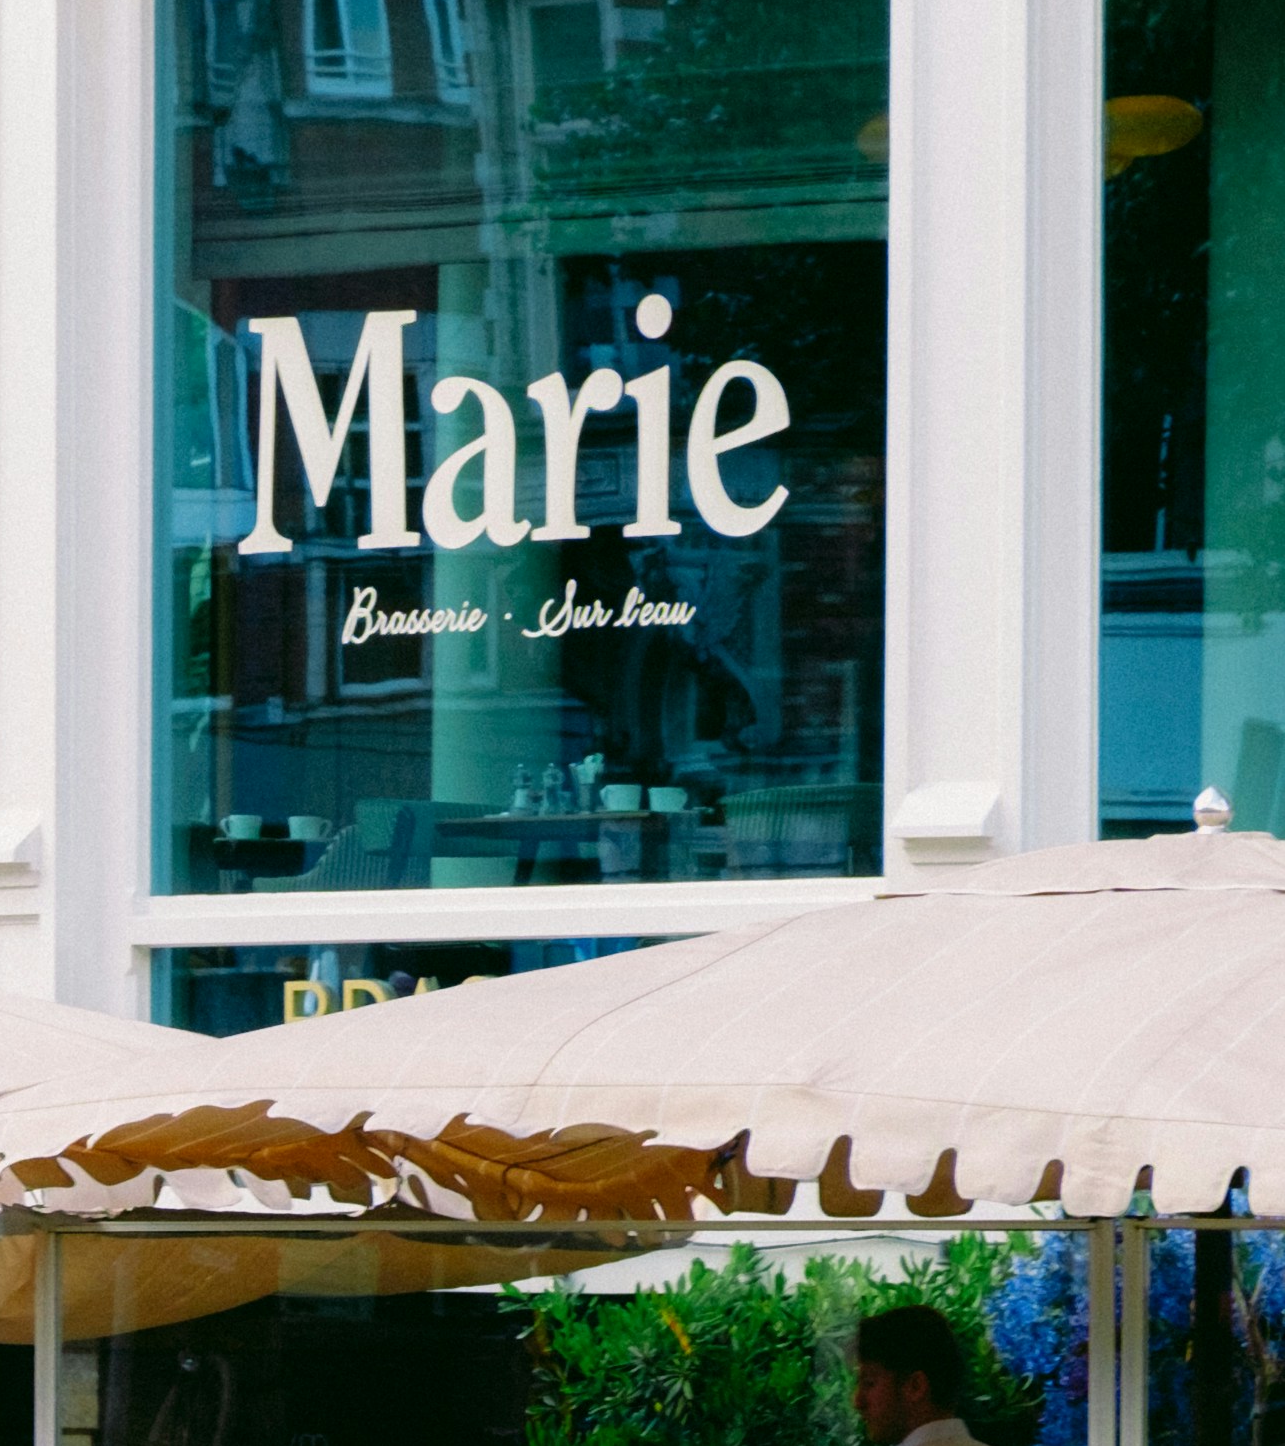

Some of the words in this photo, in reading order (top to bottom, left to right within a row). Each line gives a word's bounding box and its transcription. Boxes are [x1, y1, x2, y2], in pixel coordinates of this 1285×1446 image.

[237, 293, 791, 556] Marie
[340, 585, 489, 645] Brasserie
[521, 578, 614, 639] Sur
[614, 585, 697, 628] l'eau
